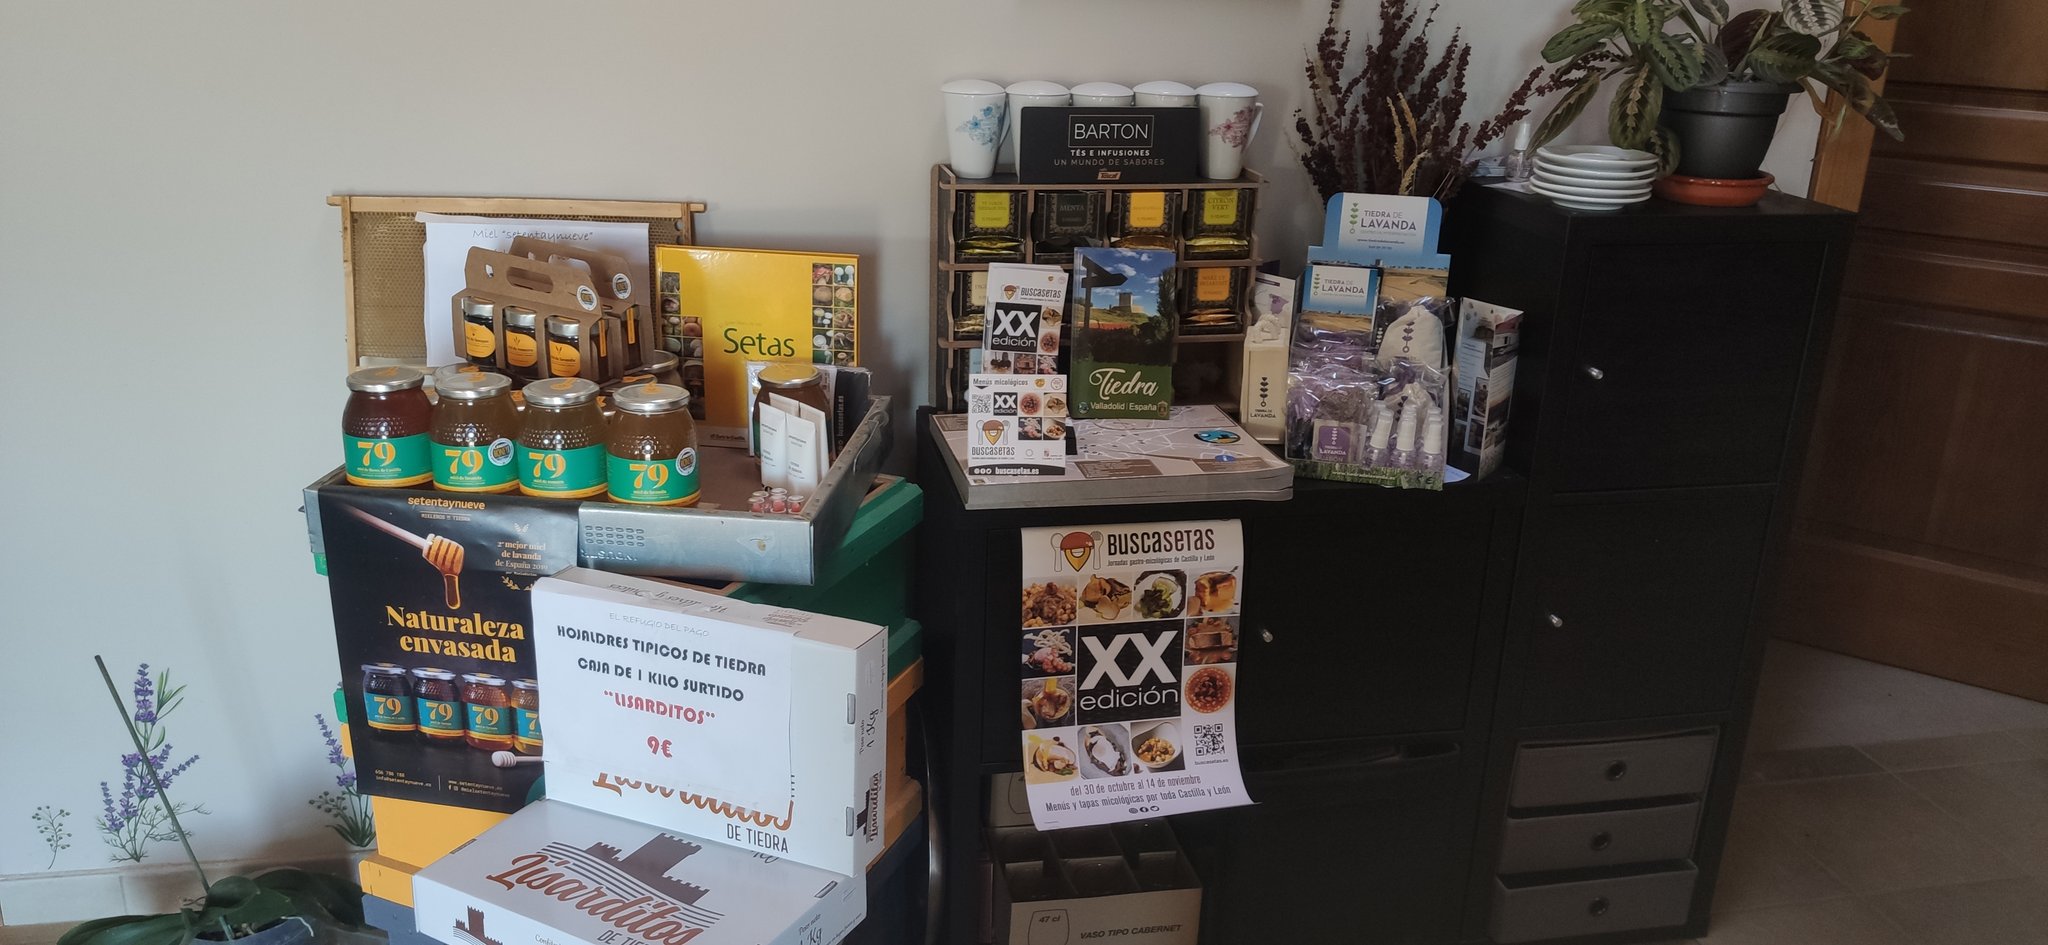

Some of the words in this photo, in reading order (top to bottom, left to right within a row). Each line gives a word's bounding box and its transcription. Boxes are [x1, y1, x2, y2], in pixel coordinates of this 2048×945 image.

[1074, 123, 1149, 140] BARTON
[1053, 158, 1067, 166] UN
[1070, 158, 1105, 166] MUNDO
[1108, 158, 1120, 166] DE
[1123, 158, 1166, 166] SABORES
[1089, 150, 1094, 160] E
[1097, 150, 1151, 160] INFUSIONES
[1059, 204, 1085, 212] MENTA
[1364, 210, 1391, 219] TIEDRA
[1392, 211, 1403, 219] DE
[473, 229, 497, 239] Miel
[1360, 218, 1417, 231] LAVANDA
[1322, 284, 1365, 294] LAVANDA
[992, 309, 1039, 338] XX
[723, 327, 795, 358] Setas
[992, 336, 1037, 347] edición
[973, 378, 993, 386] Menús
[994, 378, 1028, 387] micológicos
[1089, 367, 1160, 400] Tiedra
[994, 395, 1017, 409] XX
[1090, 401, 1125, 410] Valladolid
[1129, 402, 1157, 412] España
[357, 441, 397, 468] 79
[972, 446, 1016, 456] BUSCASETAS
[445, 449, 484, 475] 79
[528, 452, 567, 479] 79
[995, 466, 1040, 476] buscasetas.es
[629, 463, 669, 489] 79
[408, 497, 486, 511] setentaynueve
[505, 542, 528, 551] mejor
[529, 543, 547, 551] miel
[1107, 528, 1215, 556] BUSCASETAS
[495, 559, 505, 567] de
[506, 560, 531, 570] España
[501, 550, 512, 558] de
[512, 551, 542, 560] lavanda
[1107, 559, 1128, 567] Jornadas
[1181, 555, 1198, 563] Castilla
[385, 603, 527, 641] Naturaleza
[609, 612, 620, 622] EL
[622, 614, 662, 629] REFUGIO
[664, 622, 682, 632] DEL
[683, 626, 710, 638] PAGO
[399, 634, 518, 663] envasada
[557, 625, 629, 649] HOJALDRES
[632, 639, 688, 662] TIPICOS
[692, 650, 711, 666] DE
[715, 655, 766, 677] TIEDRA
[1078, 630, 1179, 691] XX
[577, 657, 610, 675] CAJA
[614, 664, 633, 679] DE
[648, 671, 679, 689] KILO
[683, 678, 745, 702] SURTIDO
[374, 696, 402, 716] 79
[603, 690, 716, 725] "LISARDITOS"
[1079, 685, 1179, 711] edición
[426, 701, 453, 721] 79
[472, 705, 500, 726] 79
[646, 735, 673, 759] 9€
[1070, 785, 1082, 796] del
[1083, 784, 1095, 796] 30
[1095, 783, 1105, 794] de
[1107, 781, 1136, 793] octubre
[1137, 779, 1144, 790] al
[1146, 778, 1155, 789] 14
[1156, 777, 1166, 788] de
[1166, 774, 1202, 787] noviembre
[1045, 801, 1071, 812] Menús
[1072, 803, 1077, 811] y
[1078, 799, 1100, 809] tapas
[1101, 794, 1145, 807] micológicas
[1146, 794, 1158, 803] por
[1160, 790, 1177, 800] toda
[1177, 787, 1206, 799] Castilla
[1206, 788, 1212, 797] y
[1212, 784, 1232, 796] León
[727, 823, 742, 842] DE
[746, 828, 789, 854] TIEDRA
[485, 852, 704, 945] Lisarditos
[1038, 915, 1050, 923] 47
[1080, 930, 1105, 940] VASO
[1107, 928, 1129, 937] TIPO
[1130, 924, 1183, 935] CABERNET
